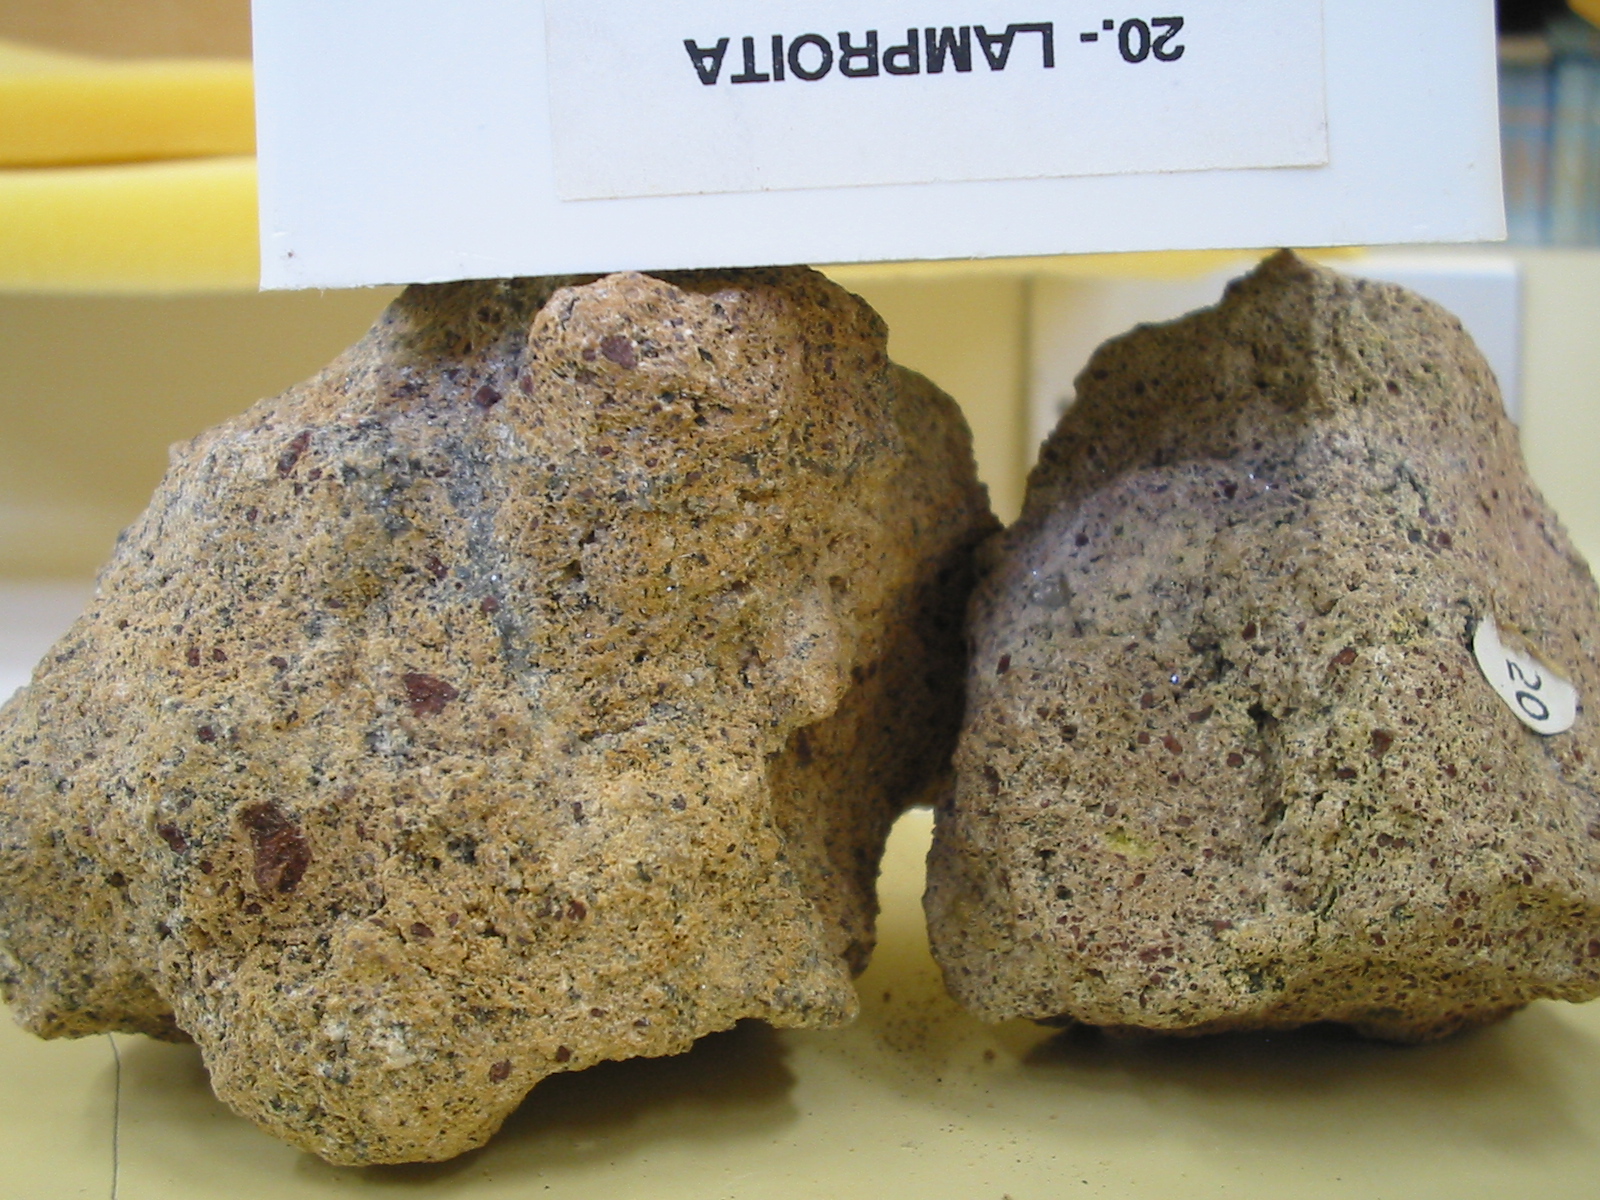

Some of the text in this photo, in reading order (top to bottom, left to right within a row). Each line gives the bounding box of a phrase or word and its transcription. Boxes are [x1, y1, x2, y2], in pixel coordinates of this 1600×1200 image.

[683, 16, 1185, 86] 20.- LAMPROITA
[1505, 659, 1549, 721] 20
